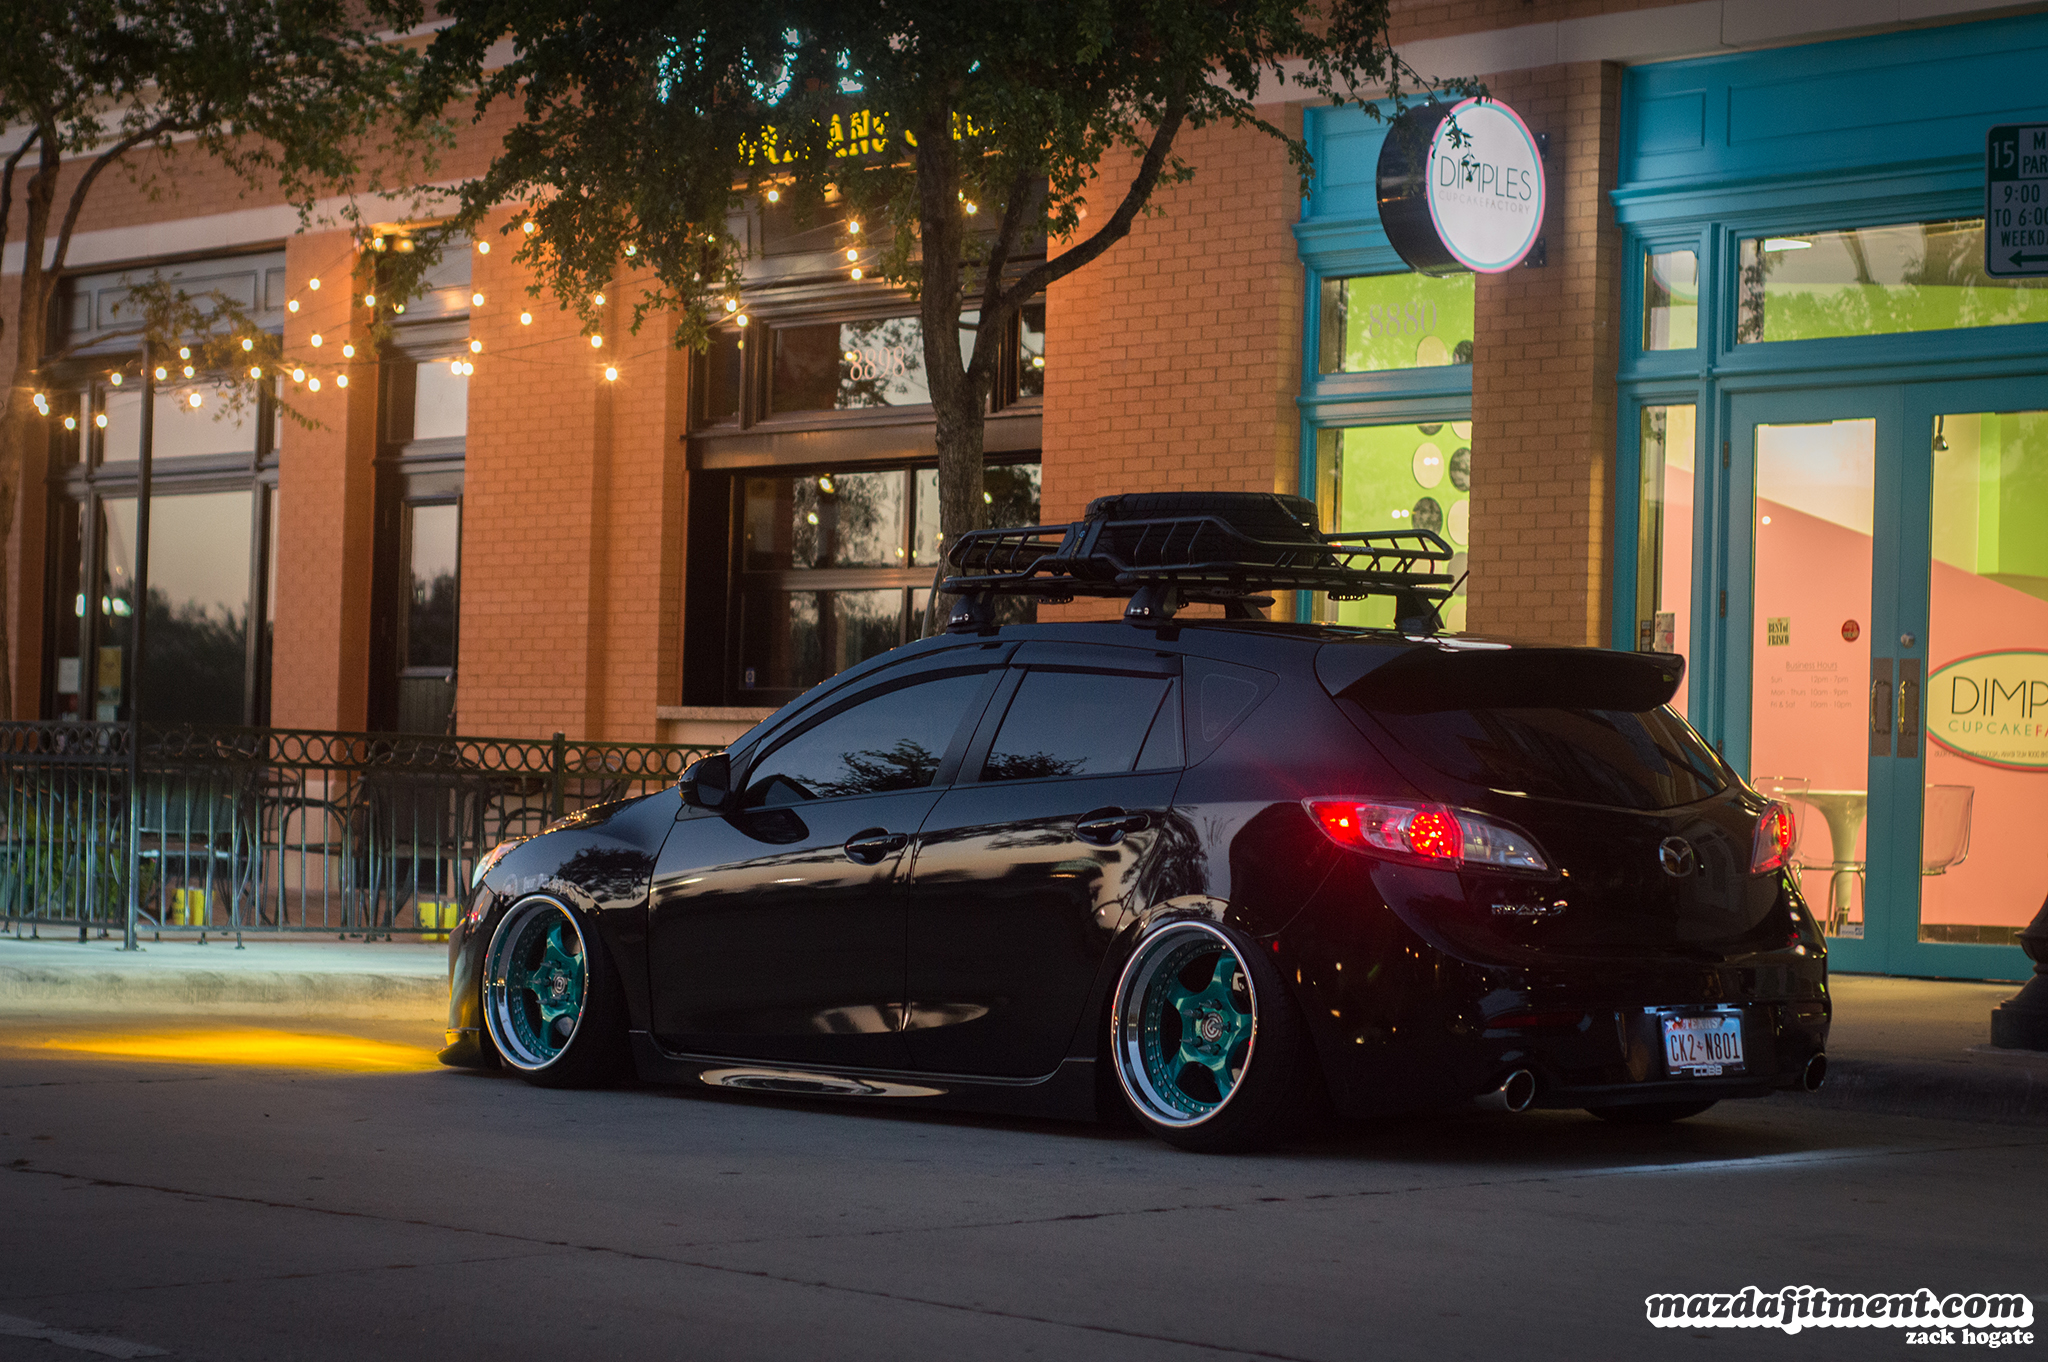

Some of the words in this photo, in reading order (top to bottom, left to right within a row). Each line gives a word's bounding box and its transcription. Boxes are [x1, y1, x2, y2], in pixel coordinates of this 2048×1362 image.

[1993, 141, 2015, 169] 15
[2023, 155, 2048, 174] PAR
[1440, 155, 1532, 202] DIMPLES
[2004, 184, 2040, 203] 9:00
[1994, 209, 2011, 227] TO
[2001, 229, 2048, 247] WEEKD
[1368, 300, 1437, 339] 8880
[850, 345, 905, 381] 8898
[1768, 622, 1782, 633] BEST
[1768, 634, 1789, 646] FRISCO
[1785, 661, 1815, 670] Business
[1817, 661, 1838, 670] Hours
[1952, 676, 2048, 719] DIMP
[1948, 719, 2048, 738] CUPCAKEF
[1684, 1017, 1718, 1030] TEXAS
